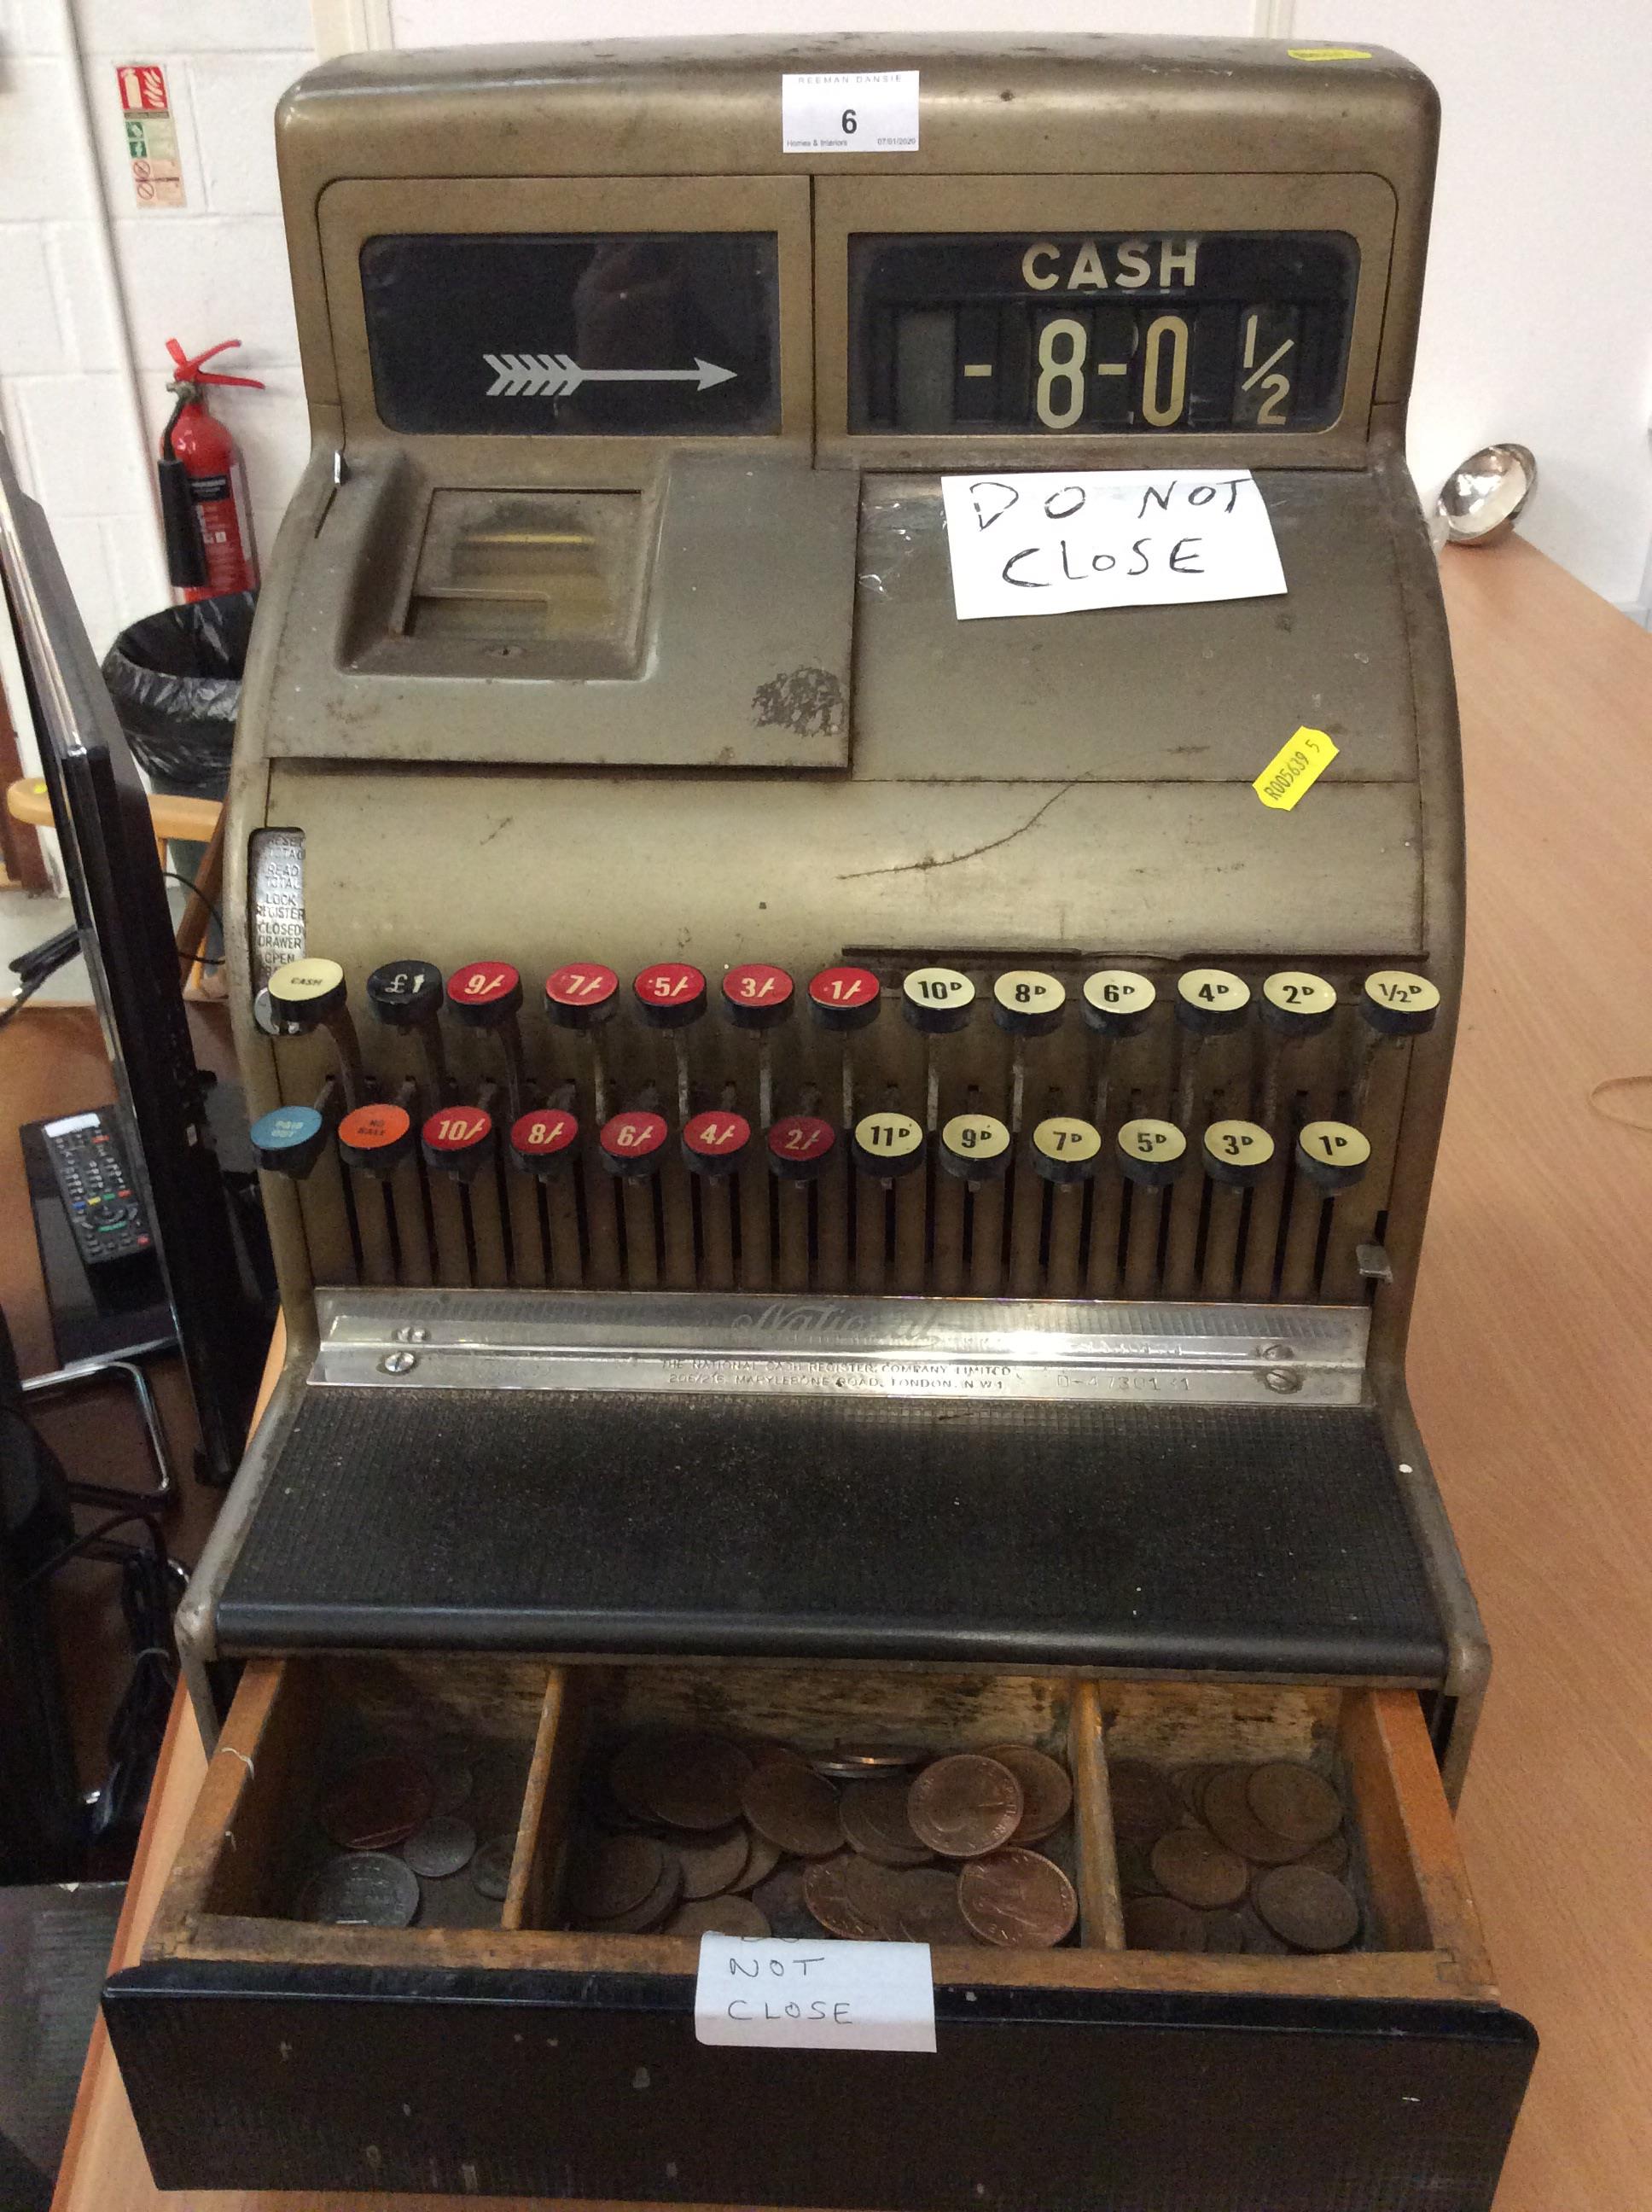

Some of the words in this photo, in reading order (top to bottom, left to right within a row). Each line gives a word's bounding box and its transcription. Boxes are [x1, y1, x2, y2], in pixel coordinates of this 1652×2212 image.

[856, 74, 902, 83] DANSIE
[841, 109, 858, 134] 6
[1022, 240, 1200, 291] CASH
[969, 481, 1086, 532] DO
[1137, 478, 1254, 519] NOT
[1263, 751, 1310, 800] R005639
[1305, 739, 1320, 753] 5
[266, 893, 297, 905] LOCK
[256, 905, 305, 921] REGISTER
[259, 922, 301, 936] CLOSED
[258, 935, 302, 950] DRAWER
[265, 952, 295, 965] OPEN
[290, 977, 323, 986] CASH
[384, 974, 425, 993] £1
[729, 1957, 825, 1978] NOT
[728, 2000, 853, 2024] CLOSE
